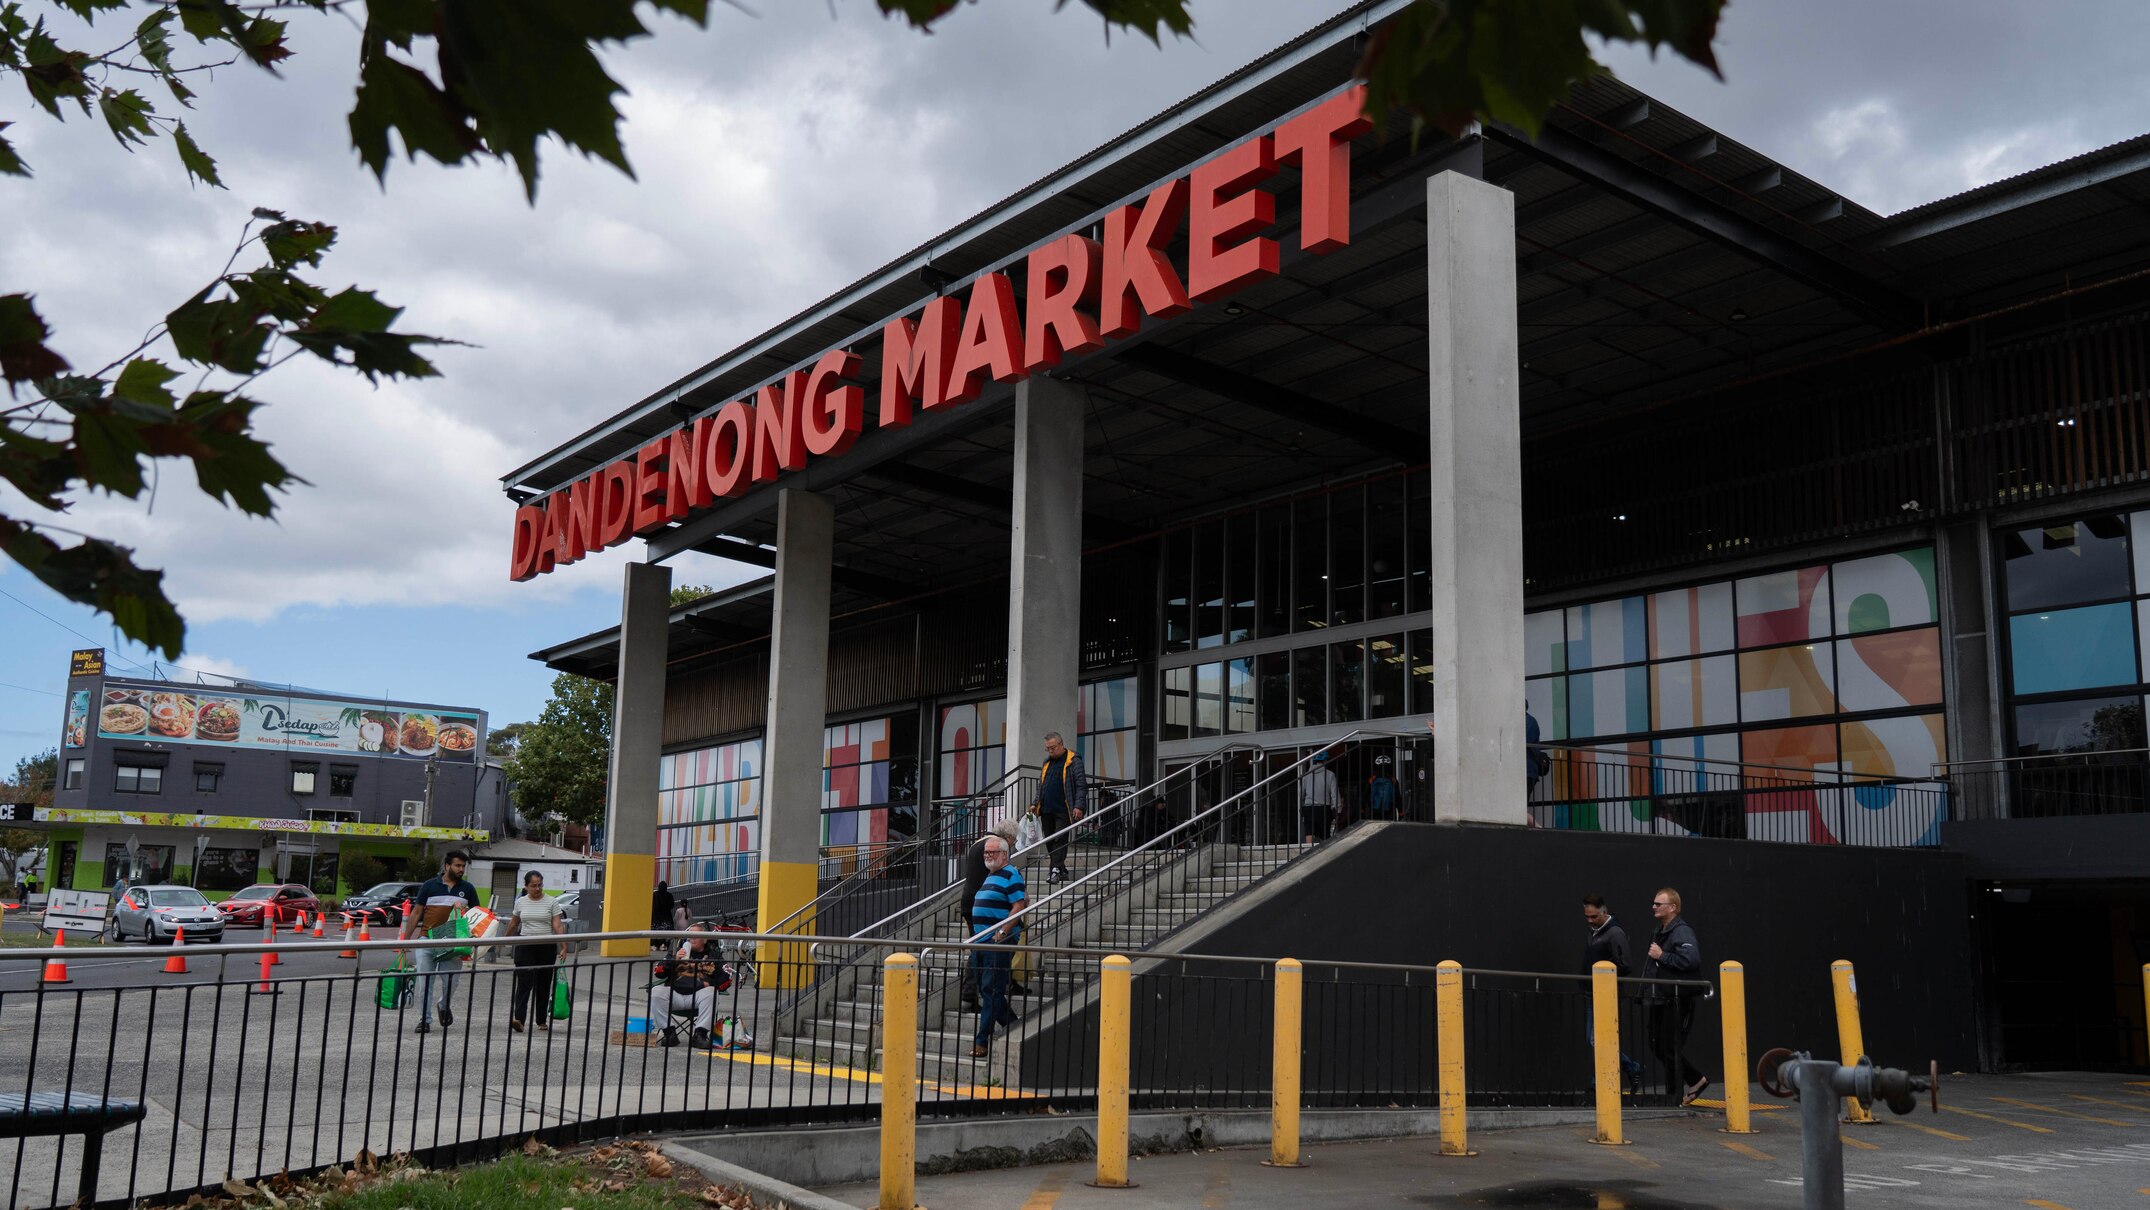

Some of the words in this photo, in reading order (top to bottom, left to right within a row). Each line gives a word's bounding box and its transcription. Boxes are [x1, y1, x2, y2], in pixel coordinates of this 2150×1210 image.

[509, 348, 866, 583] DANDENONG
[877, 83, 1374, 429] MARKET
[73, 652, 93, 663] Malay
[83, 661, 102, 670] Asian
[257, 736, 280, 745] Malay
[0, 804, 15, 820] CE
